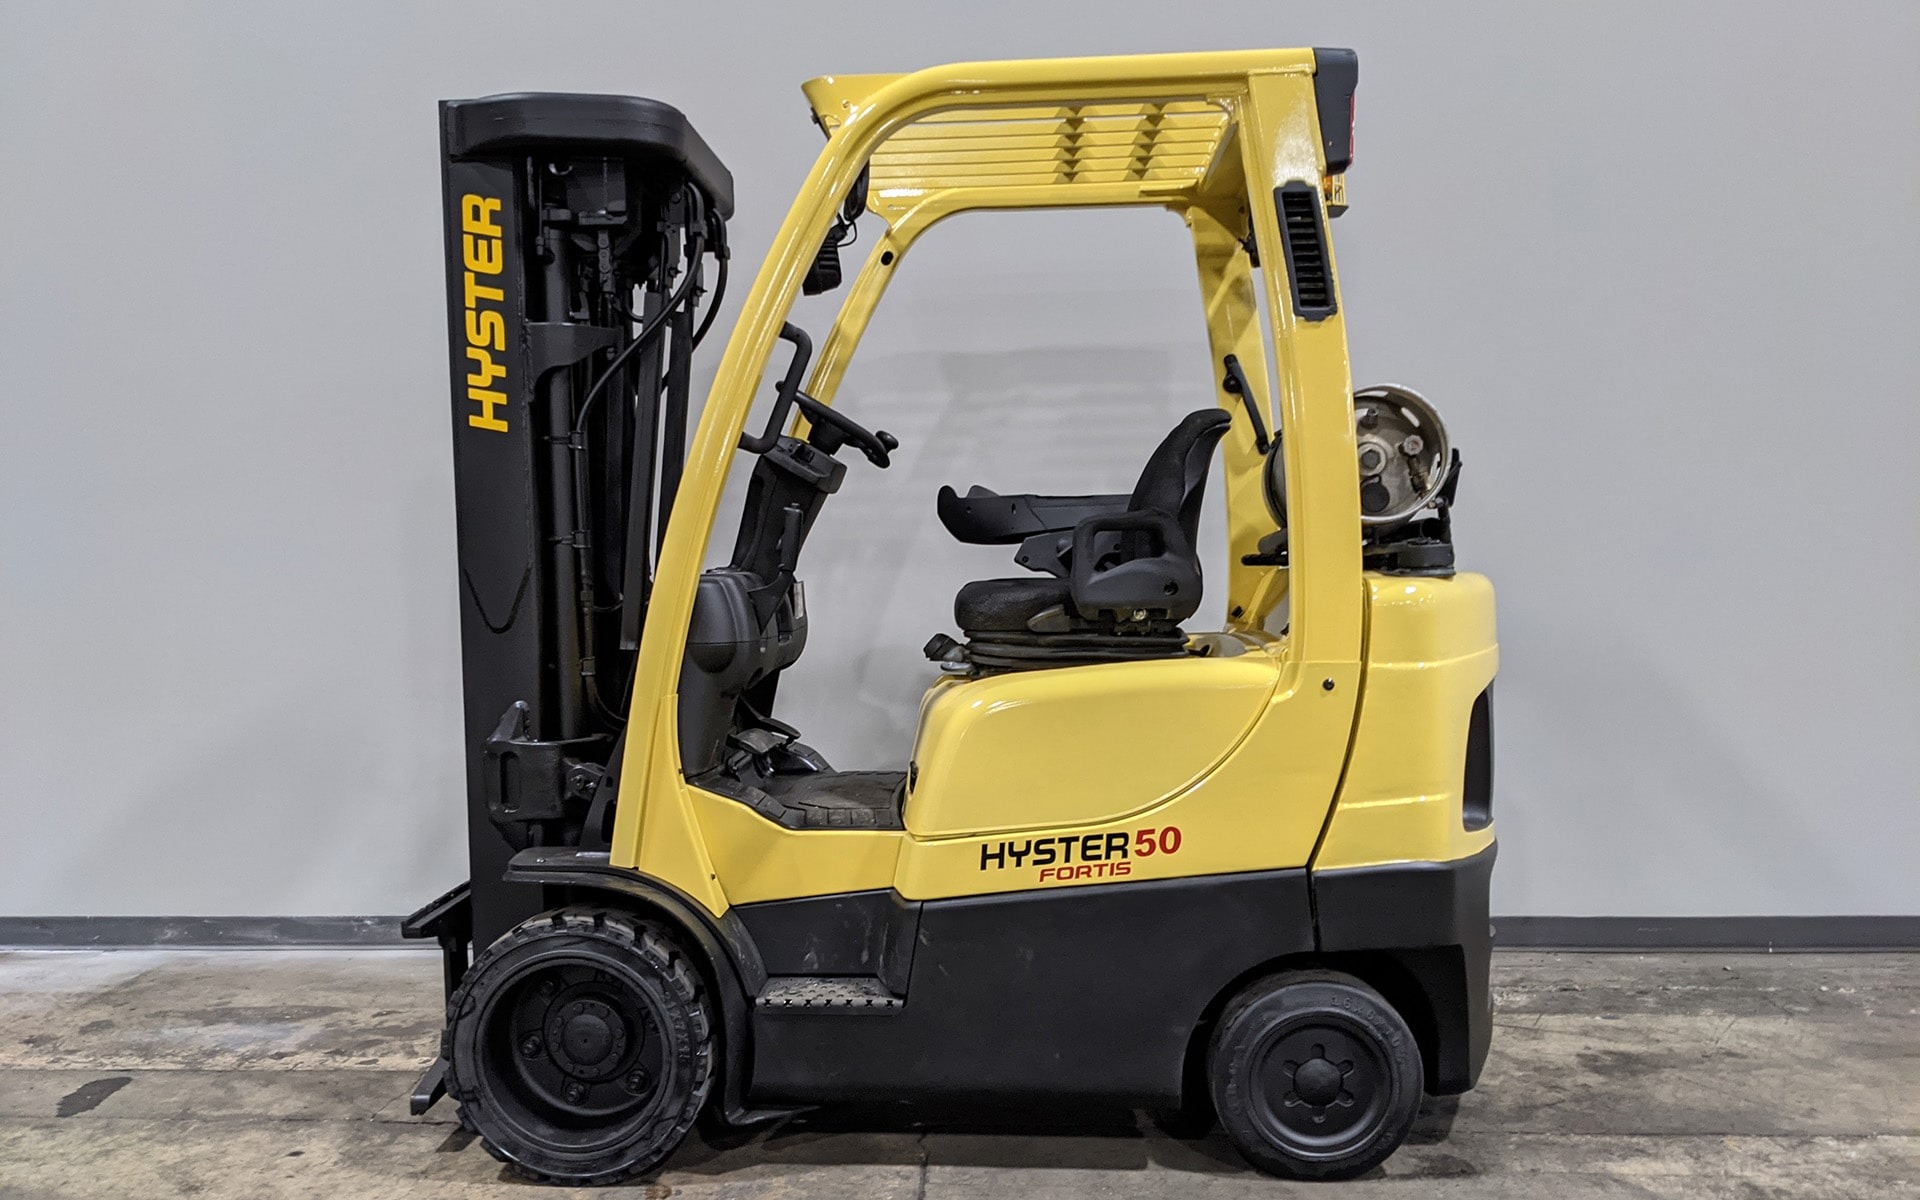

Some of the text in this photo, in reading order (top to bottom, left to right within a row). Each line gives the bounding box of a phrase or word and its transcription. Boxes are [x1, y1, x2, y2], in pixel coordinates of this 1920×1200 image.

[462, 194, 508, 432] HYSTER
[980, 826, 1182, 871] HYSTER 50
[1039, 861, 1132, 882] FORTIS
